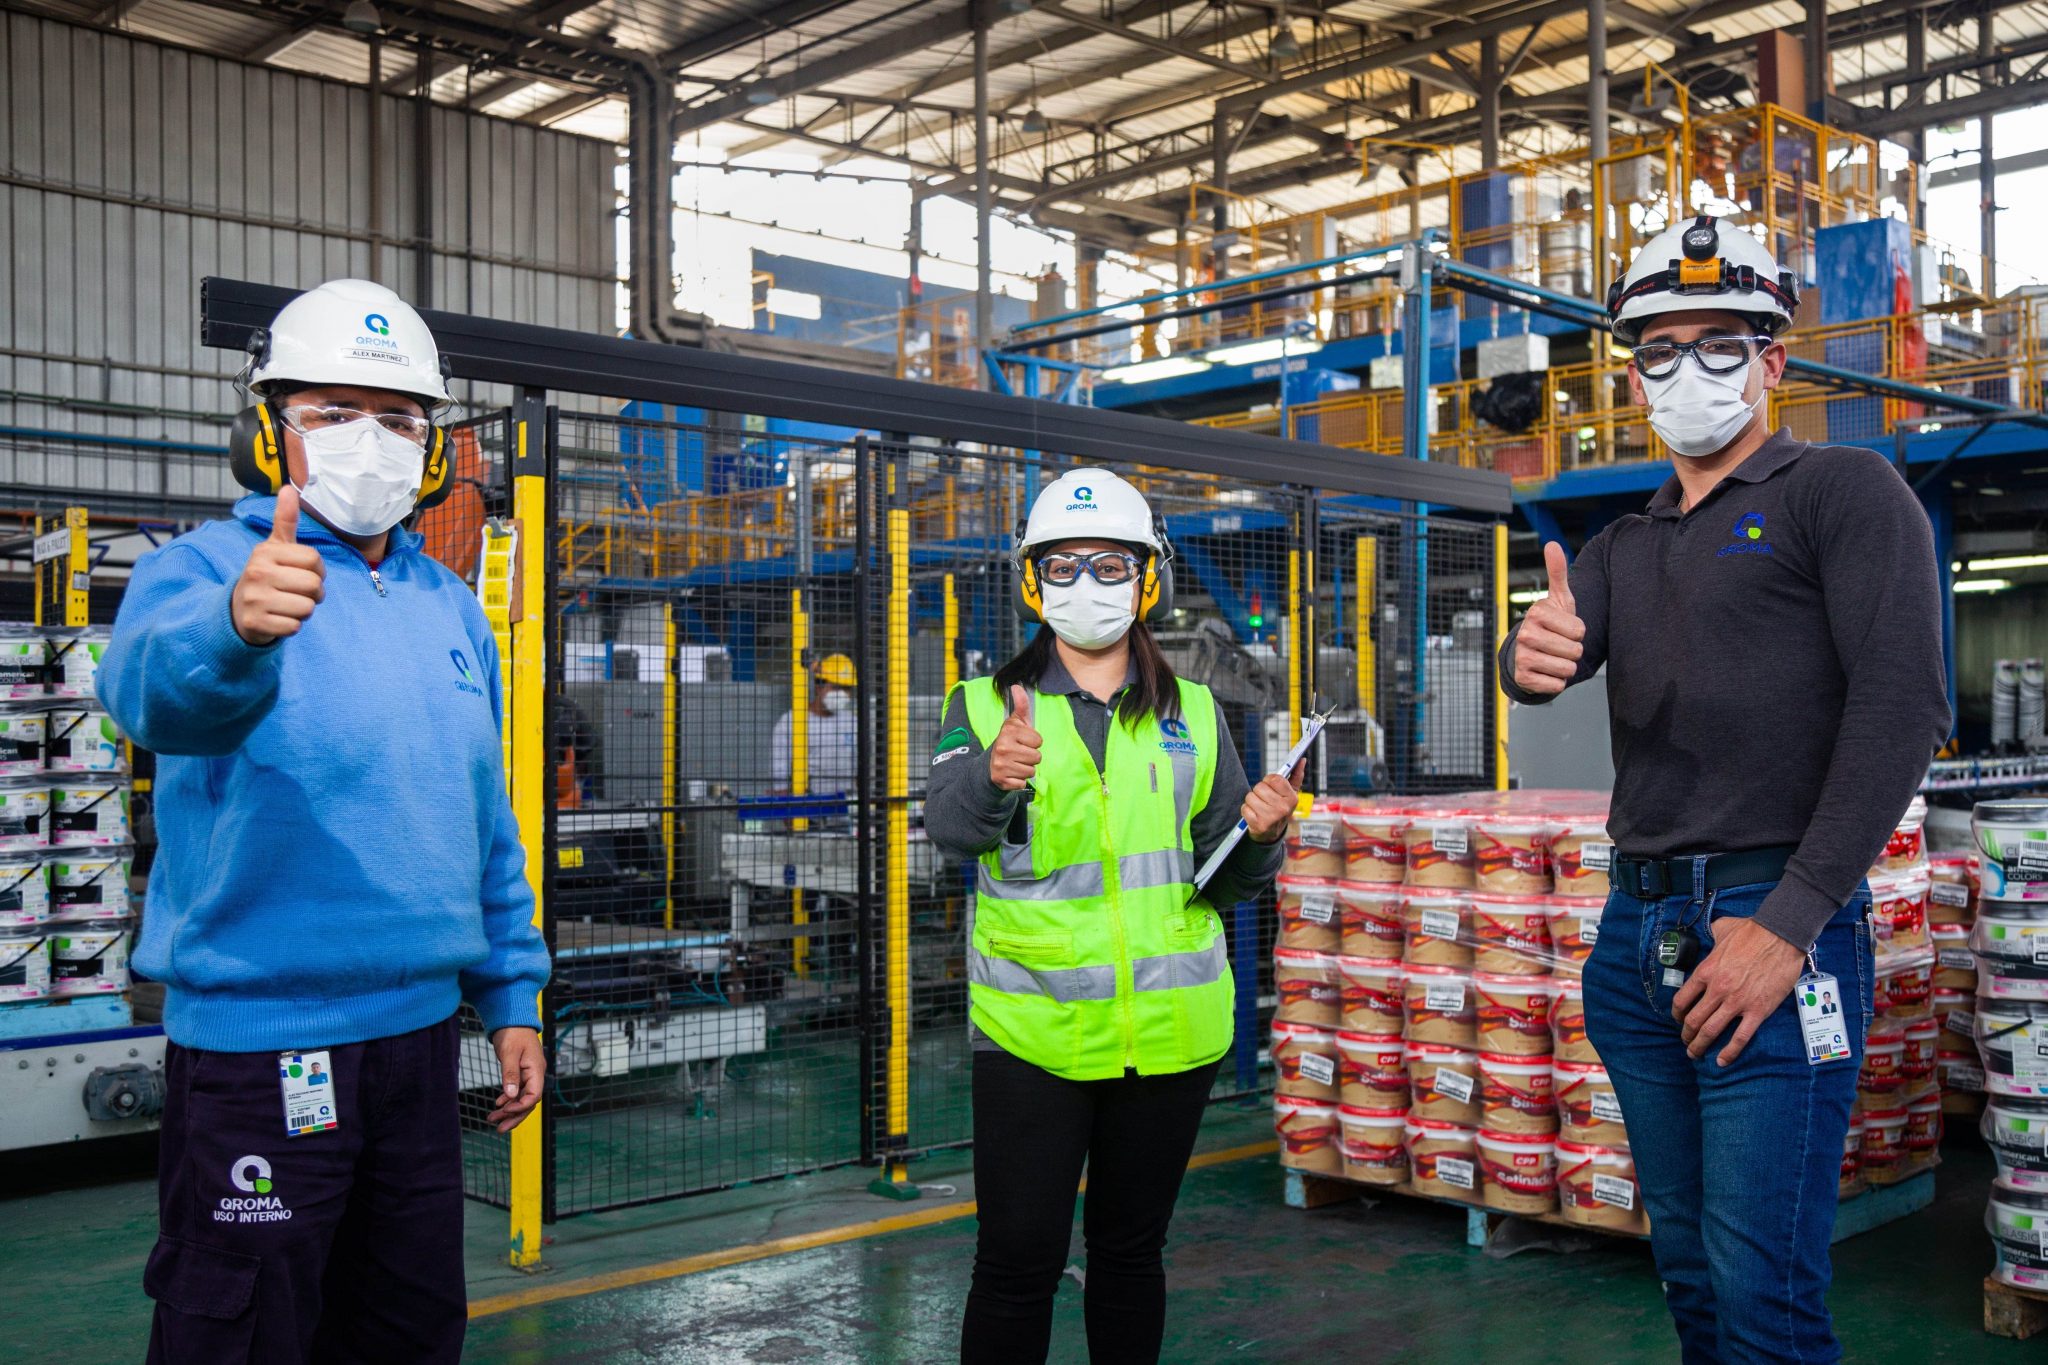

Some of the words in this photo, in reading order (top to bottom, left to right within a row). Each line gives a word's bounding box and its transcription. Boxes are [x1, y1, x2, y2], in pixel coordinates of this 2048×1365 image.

[355, 336, 398, 350] QROMA
[371, 352, 403, 363] MARTINEZ
[1066, 503, 1098, 511] QROMA
[1159, 741, 1199, 752] QROMA
[2007, 873, 2043, 881] COLORS
[1379, 1055, 1399, 1065] CPP
[1871, 1057, 1890, 1066] CPP
[1515, 1156, 1537, 1166] CPP
[220, 1197, 284, 1211] QROMA
[213, 1210, 235, 1222] USO
[240, 1209, 293, 1223] INTERNO
